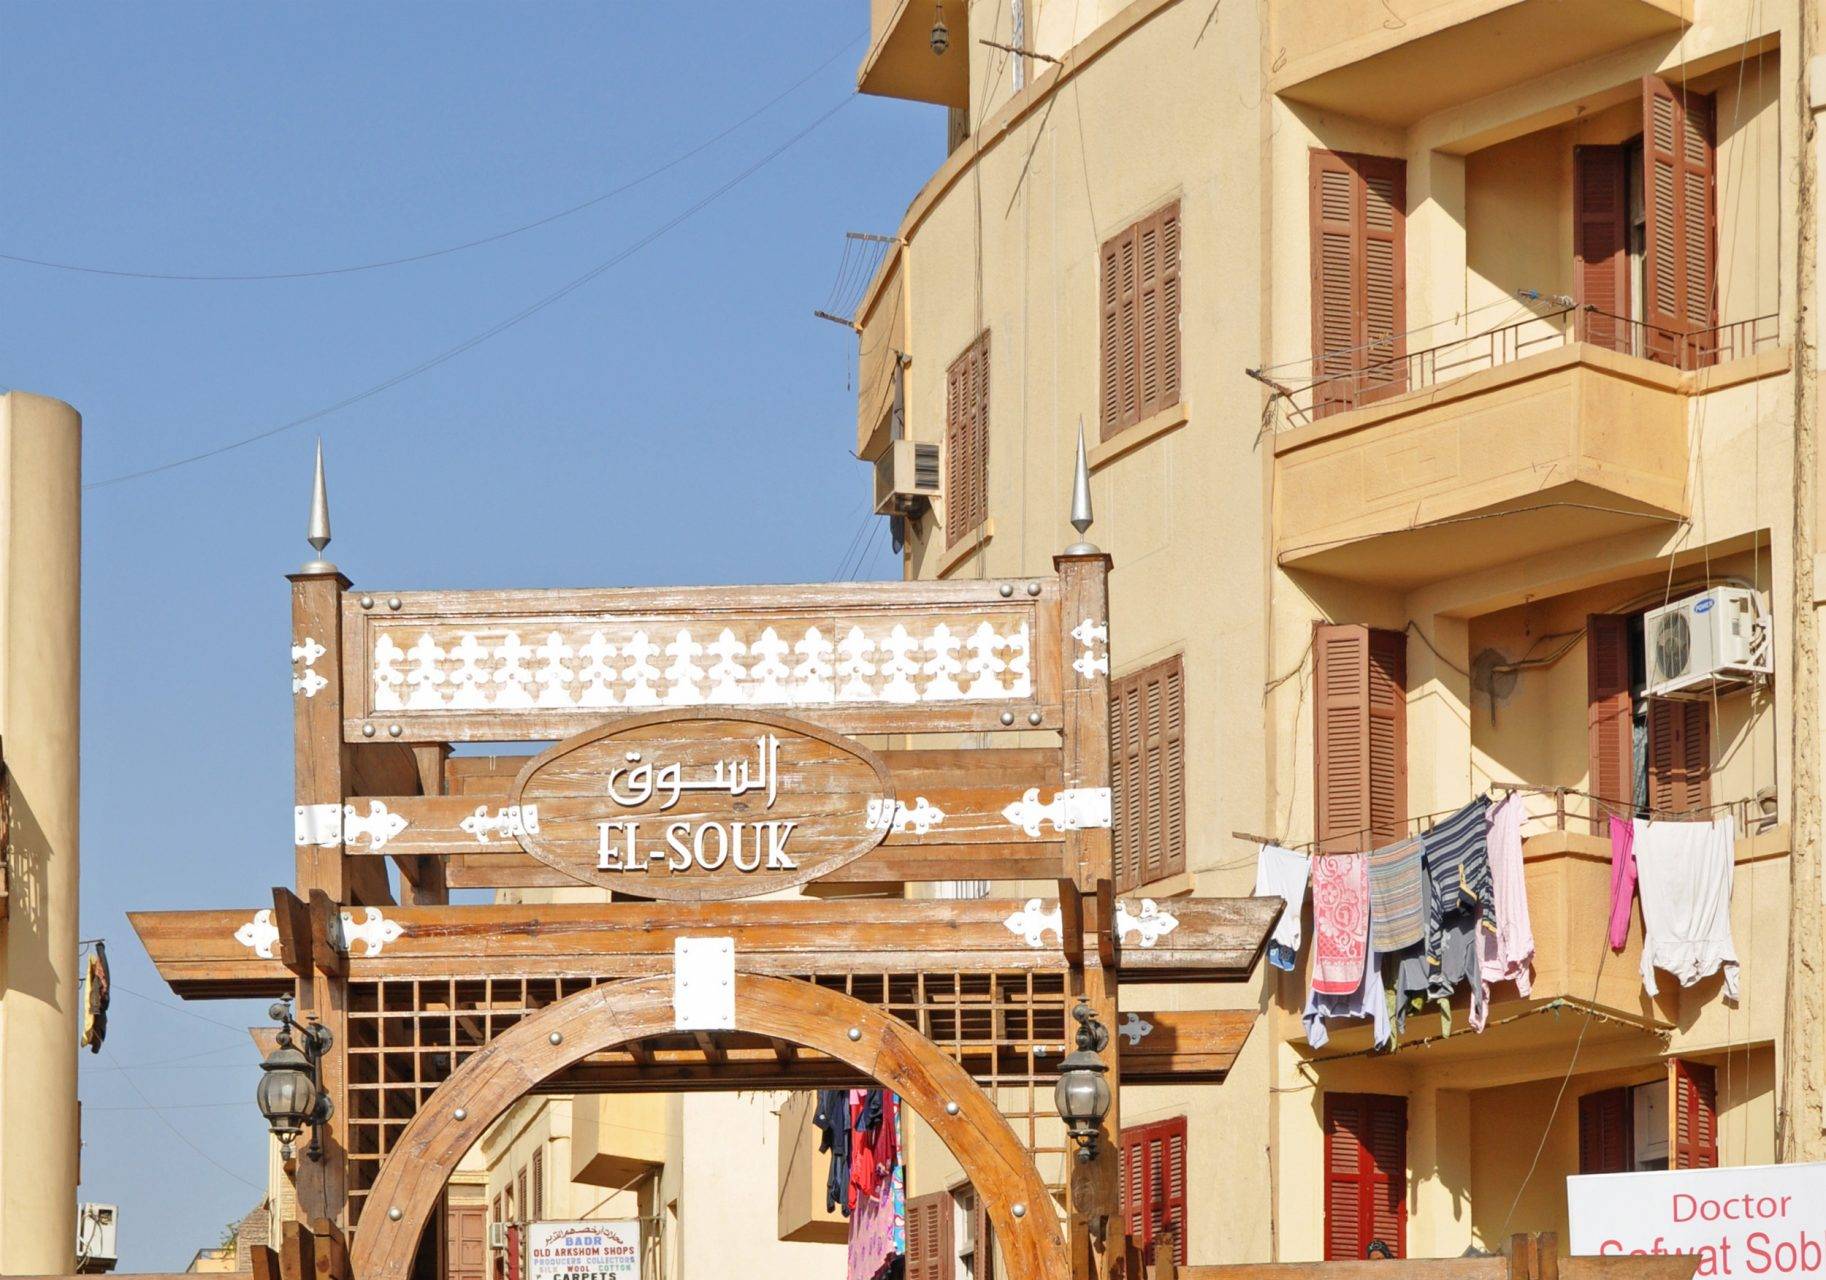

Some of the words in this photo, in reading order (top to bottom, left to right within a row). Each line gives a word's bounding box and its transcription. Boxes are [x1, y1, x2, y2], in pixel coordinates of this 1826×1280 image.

[607, 733, 782, 811] السوق
[596, 821, 800, 872] EL-SOUK
[1673, 1193, 1792, 1223] Doctor
[565, 1236, 602, 1246] BADR
[533, 1248, 551, 1257] OLD
[555, 1247, 600, 1257] ARKSHOM
[604, 1246, 635, 1256] SHOPS
[534, 1258, 582, 1266] PRODUCERS
[587, 1256, 635, 1264] COLLECTORS
[1746, 1231, 1826, 1274] Sob
[567, 1265, 590, 1273] WOOL
[598, 1264, 631, 1272] COTTON
